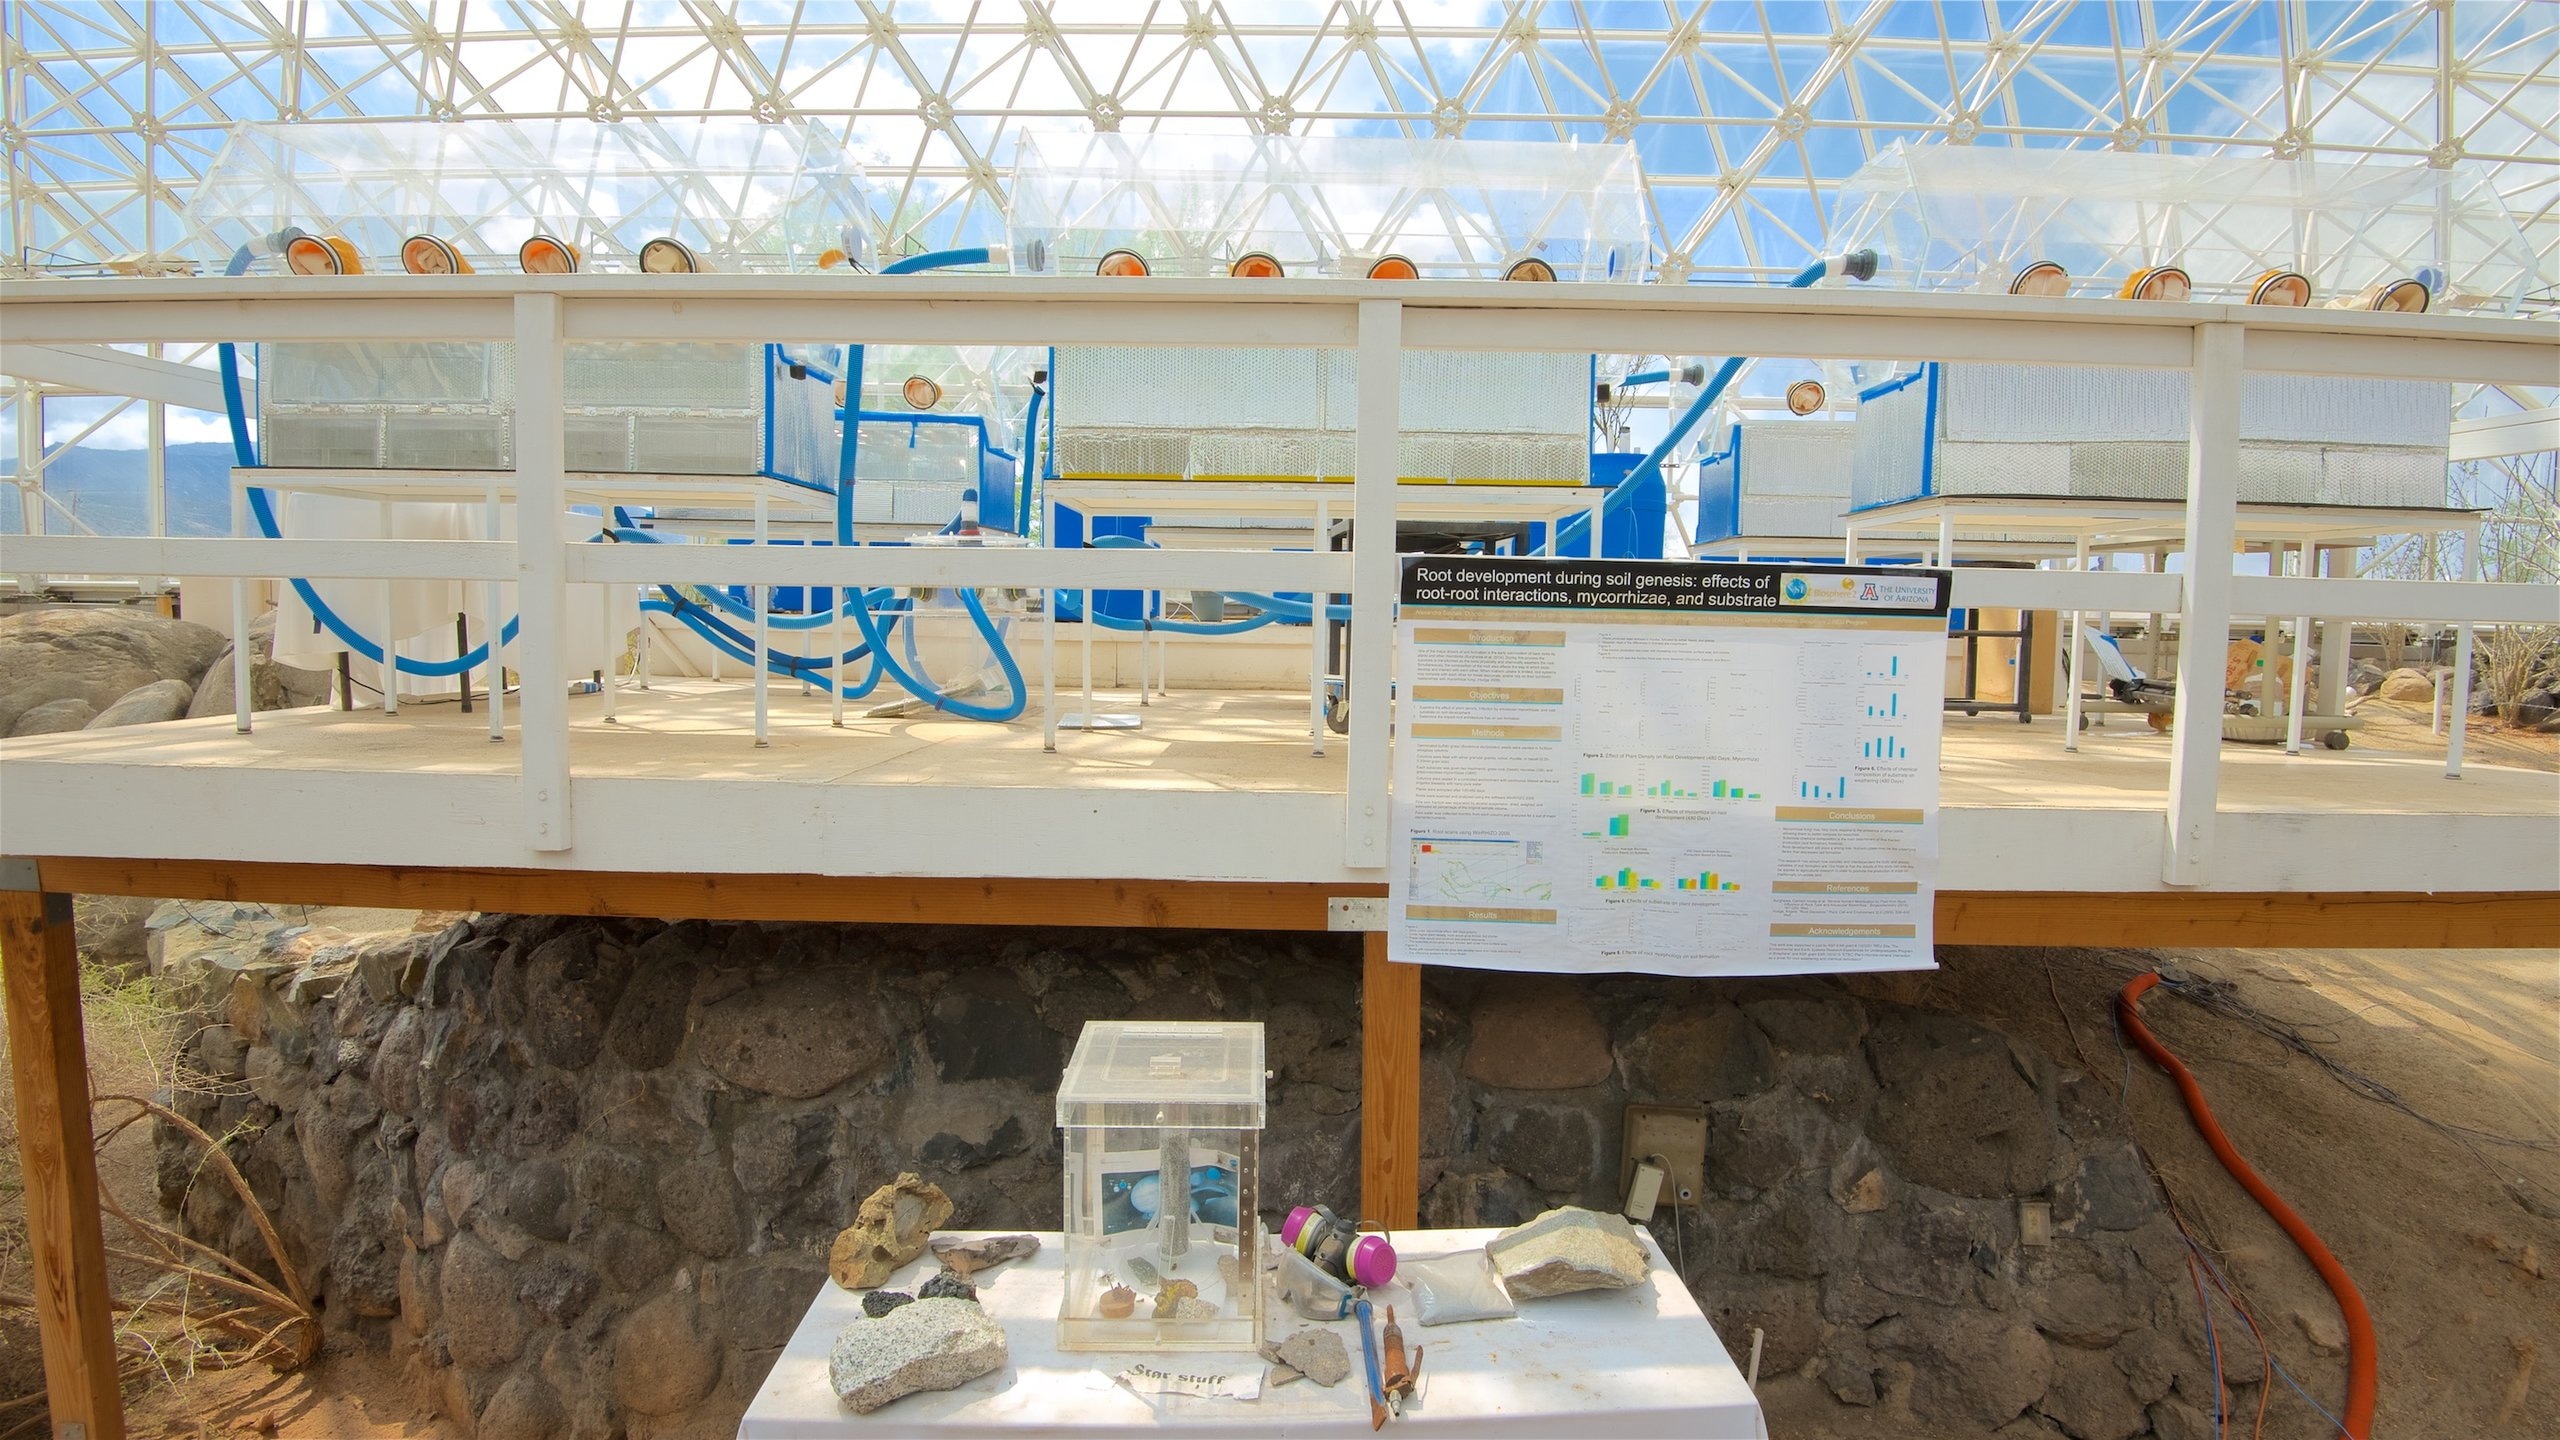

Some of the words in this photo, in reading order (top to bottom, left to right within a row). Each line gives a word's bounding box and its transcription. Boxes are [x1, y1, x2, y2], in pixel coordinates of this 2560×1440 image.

[1416, 567, 1453, 583] Root
[1456, 569, 1551, 586] development
[1555, 571, 1602, 588] during
[1605, 572, 1631, 586] soil
[1635, 573, 1698, 589] genesis:
[1702, 574, 1751, 589] effects
[1755, 575, 1771, 589] of
[1860, 582, 1879, 600] A
[1880, 584, 1894, 593] THE
[1895, 586, 1936, 596] UNIVERSITY
[1415, 587, 1479, 601] root-root
[1483, 587, 1572, 604] interactions,
[1577, 590, 1671, 606] mycorrhizae,
[1675, 592, 1704, 605] and
[1708, 593, 1777, 608] substrate
[1896, 594, 1929, 604] ARIZONA
[1468, 633, 1514, 643] Introduction
[1469, 690, 1510, 701] Objectives
[1471, 728, 1505, 737] Methods
[1828, 811, 1876, 821] Conclusions
[1826, 884, 1870, 893] References
[1468, 910, 1498, 920] Results
[1808, 927, 1881, 937] Acknowledgements
[1128, 1363, 1172, 1380] Star
[1177, 1373, 1226, 1389] stuff
